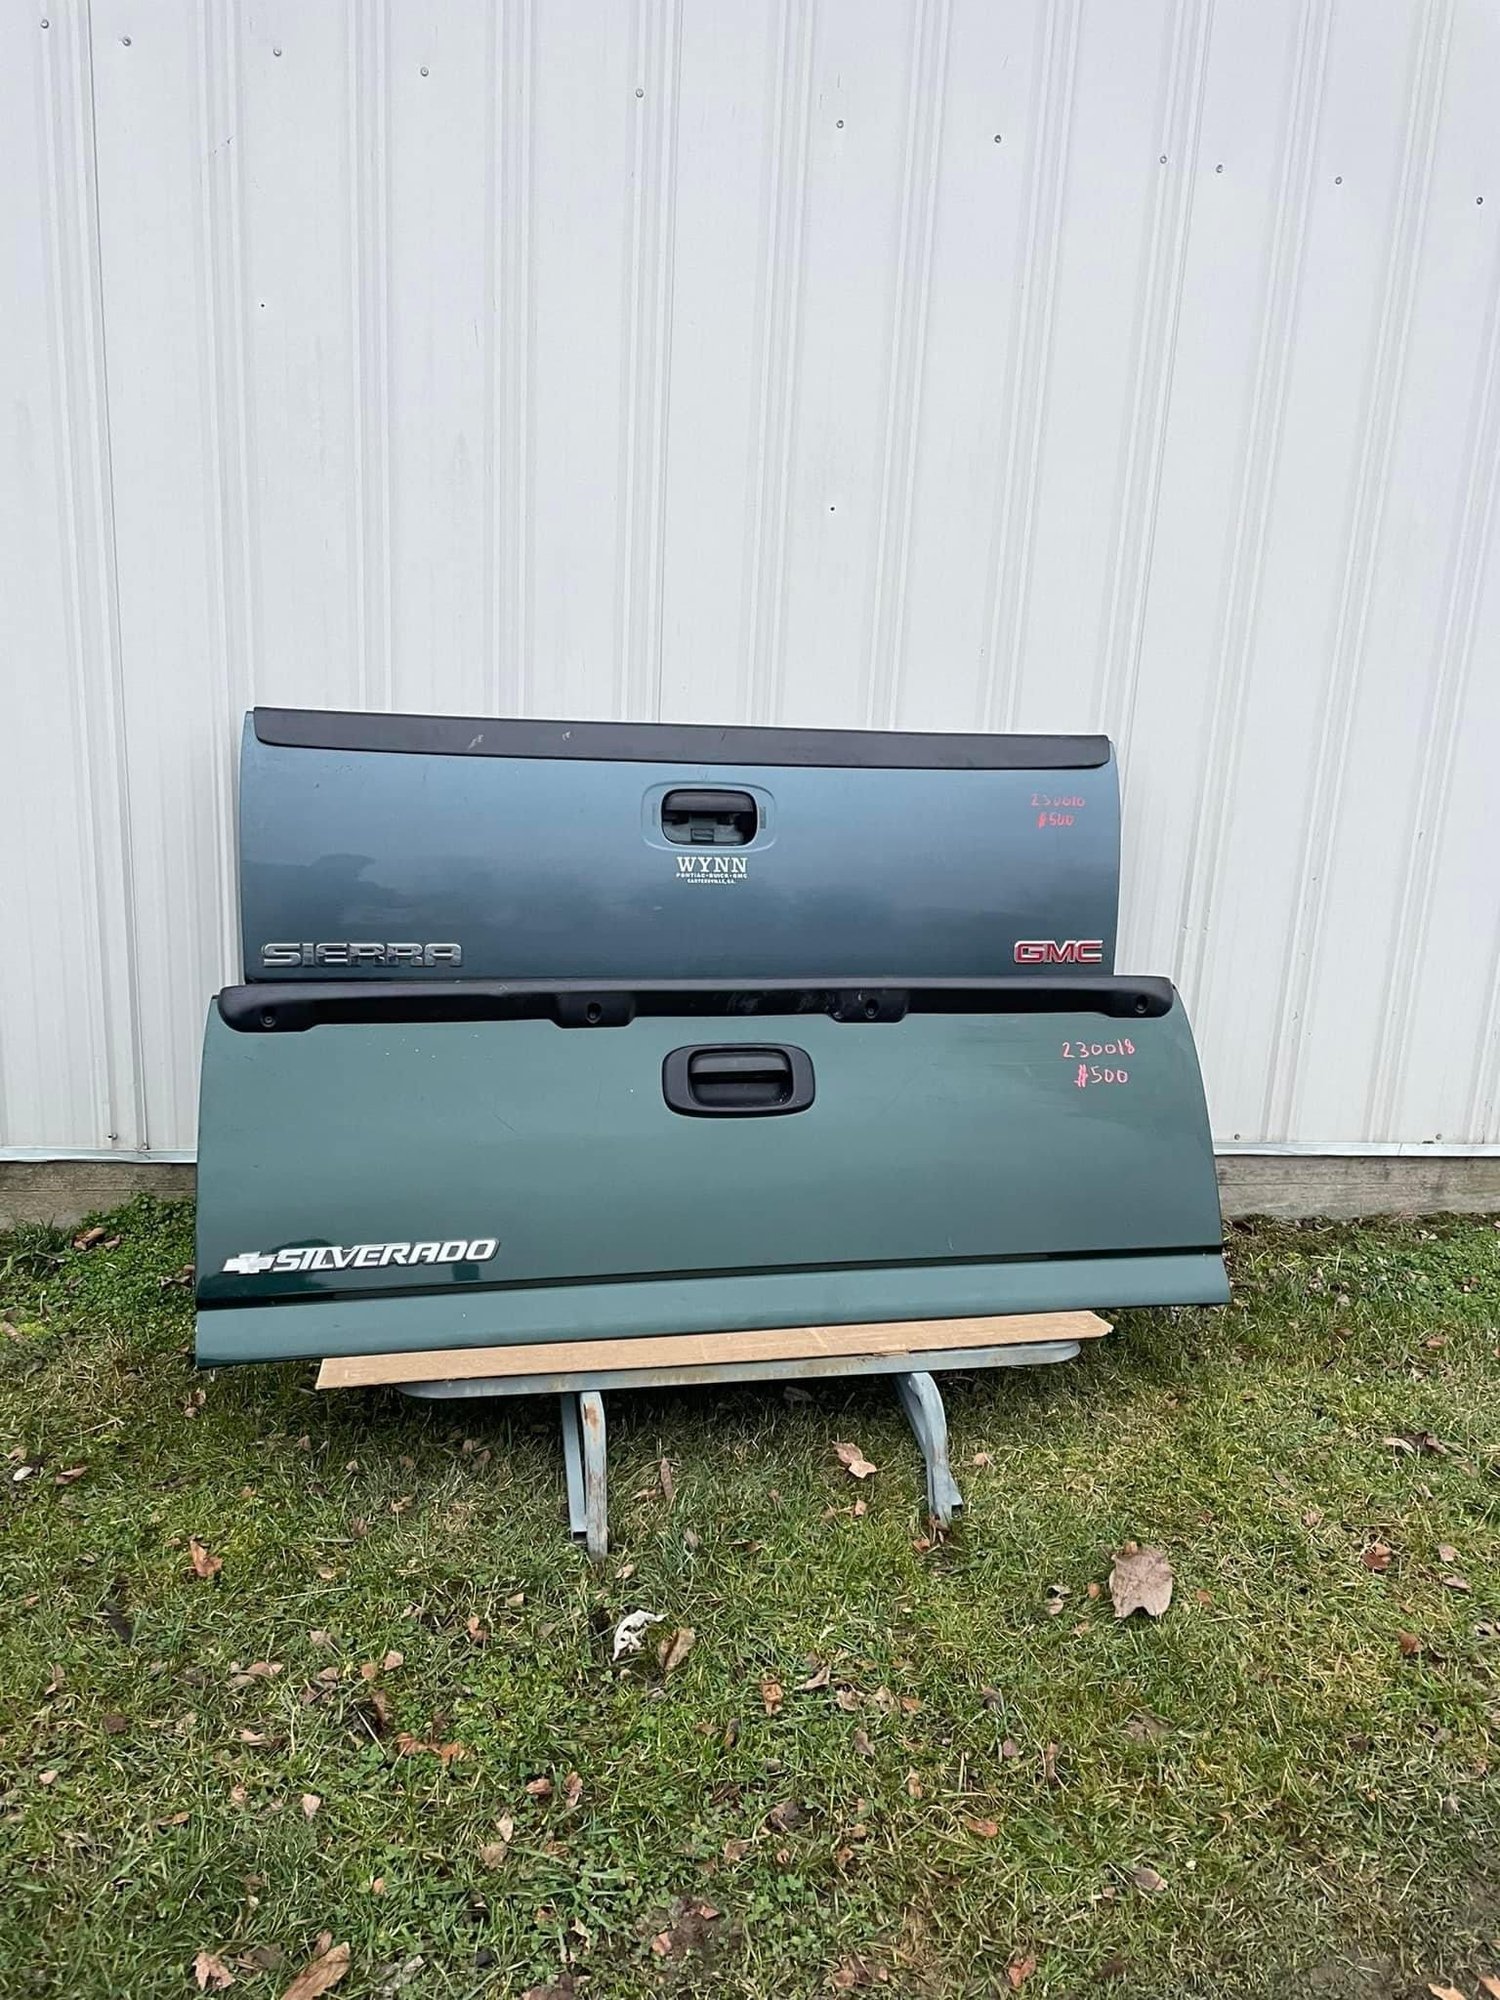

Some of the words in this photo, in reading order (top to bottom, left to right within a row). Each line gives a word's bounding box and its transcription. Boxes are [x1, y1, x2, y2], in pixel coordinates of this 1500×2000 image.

[676, 856, 748, 873] WYNN
[261, 942, 463, 967] SIERRA
[1014, 940, 1103, 963] GMC
[1062, 1038, 1136, 1058] 230018
[272, 1238, 499, 1272] SILVERADO
